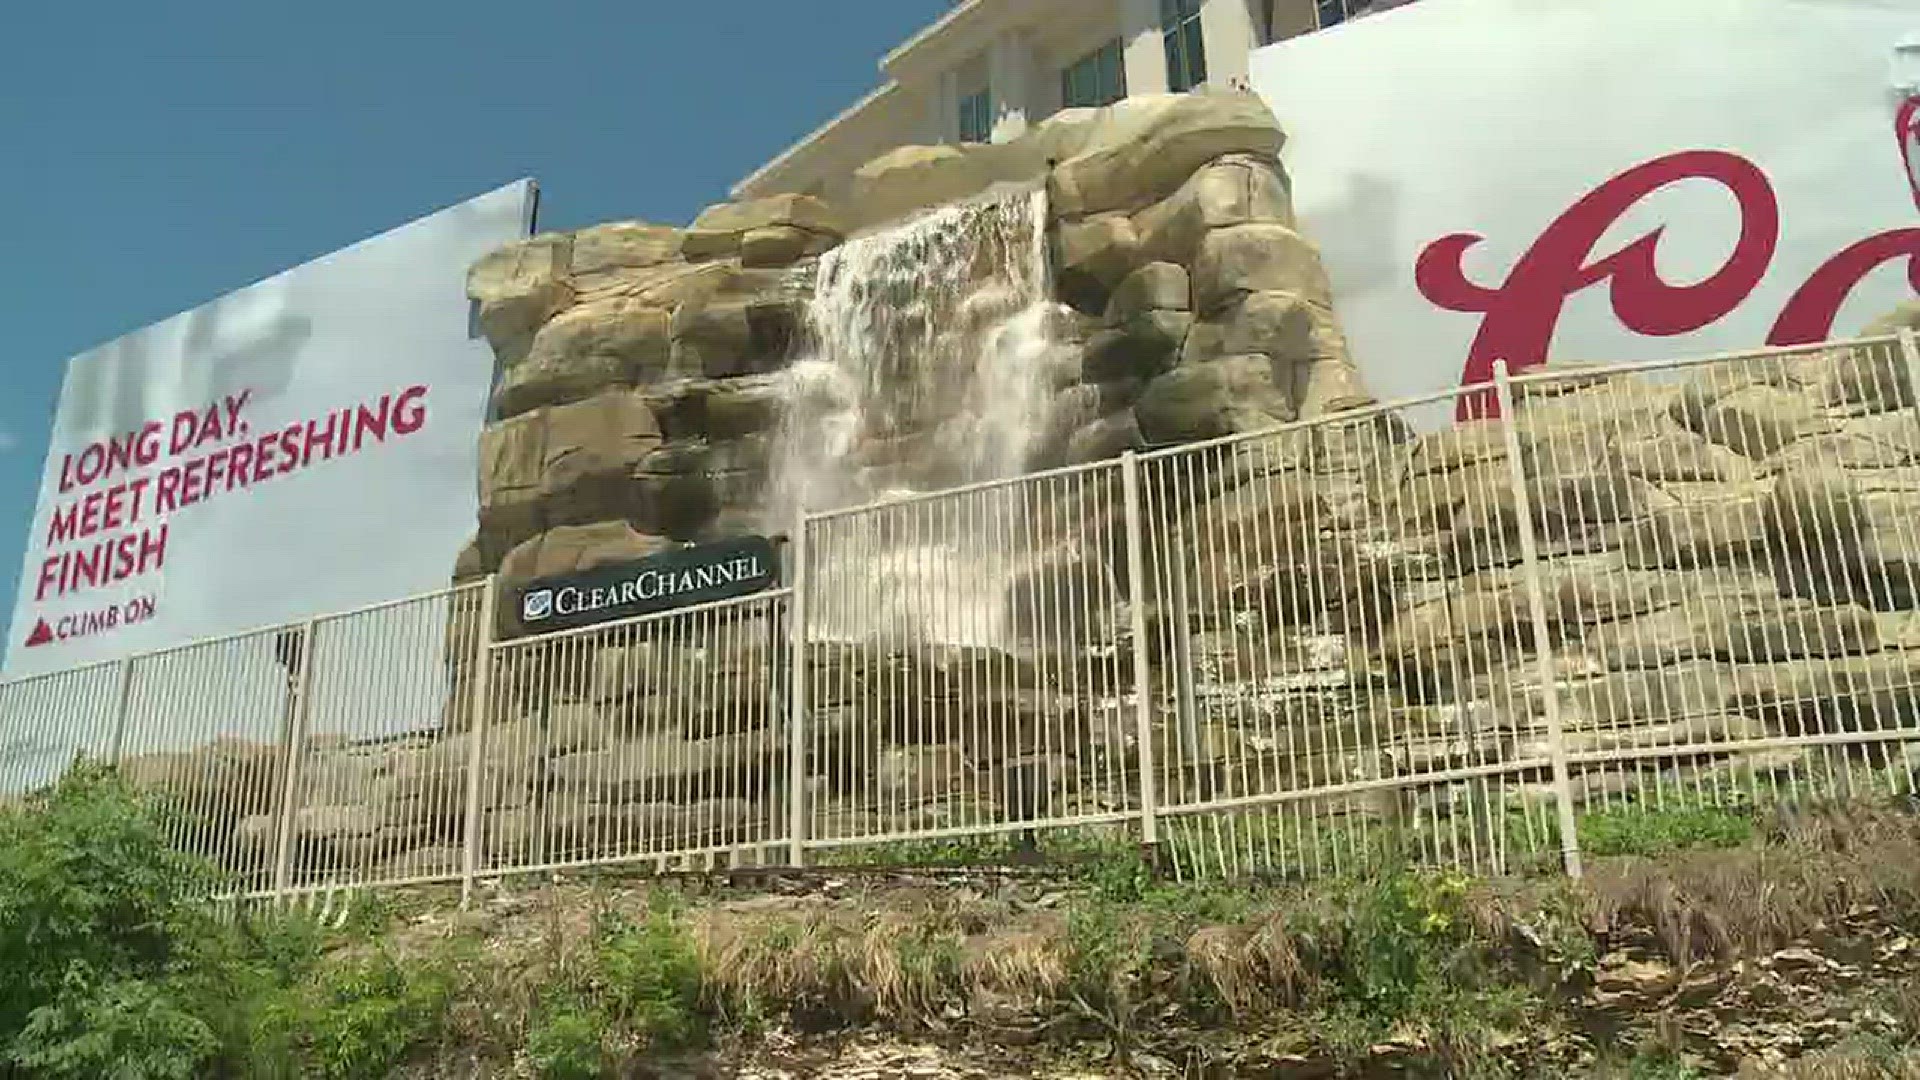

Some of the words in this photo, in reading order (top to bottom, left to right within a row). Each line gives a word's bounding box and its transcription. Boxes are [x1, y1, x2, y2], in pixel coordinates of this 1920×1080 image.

[46, 477, 150, 547] MEET
[154, 384, 428, 514] REFRESHING
[58, 421, 161, 493] LONG
[169, 388, 251, 451] DAY.
[35, 524, 168, 600] FINISH
[57, 604, 118, 640] CLIMB
[124, 594, 156, 624] ON
